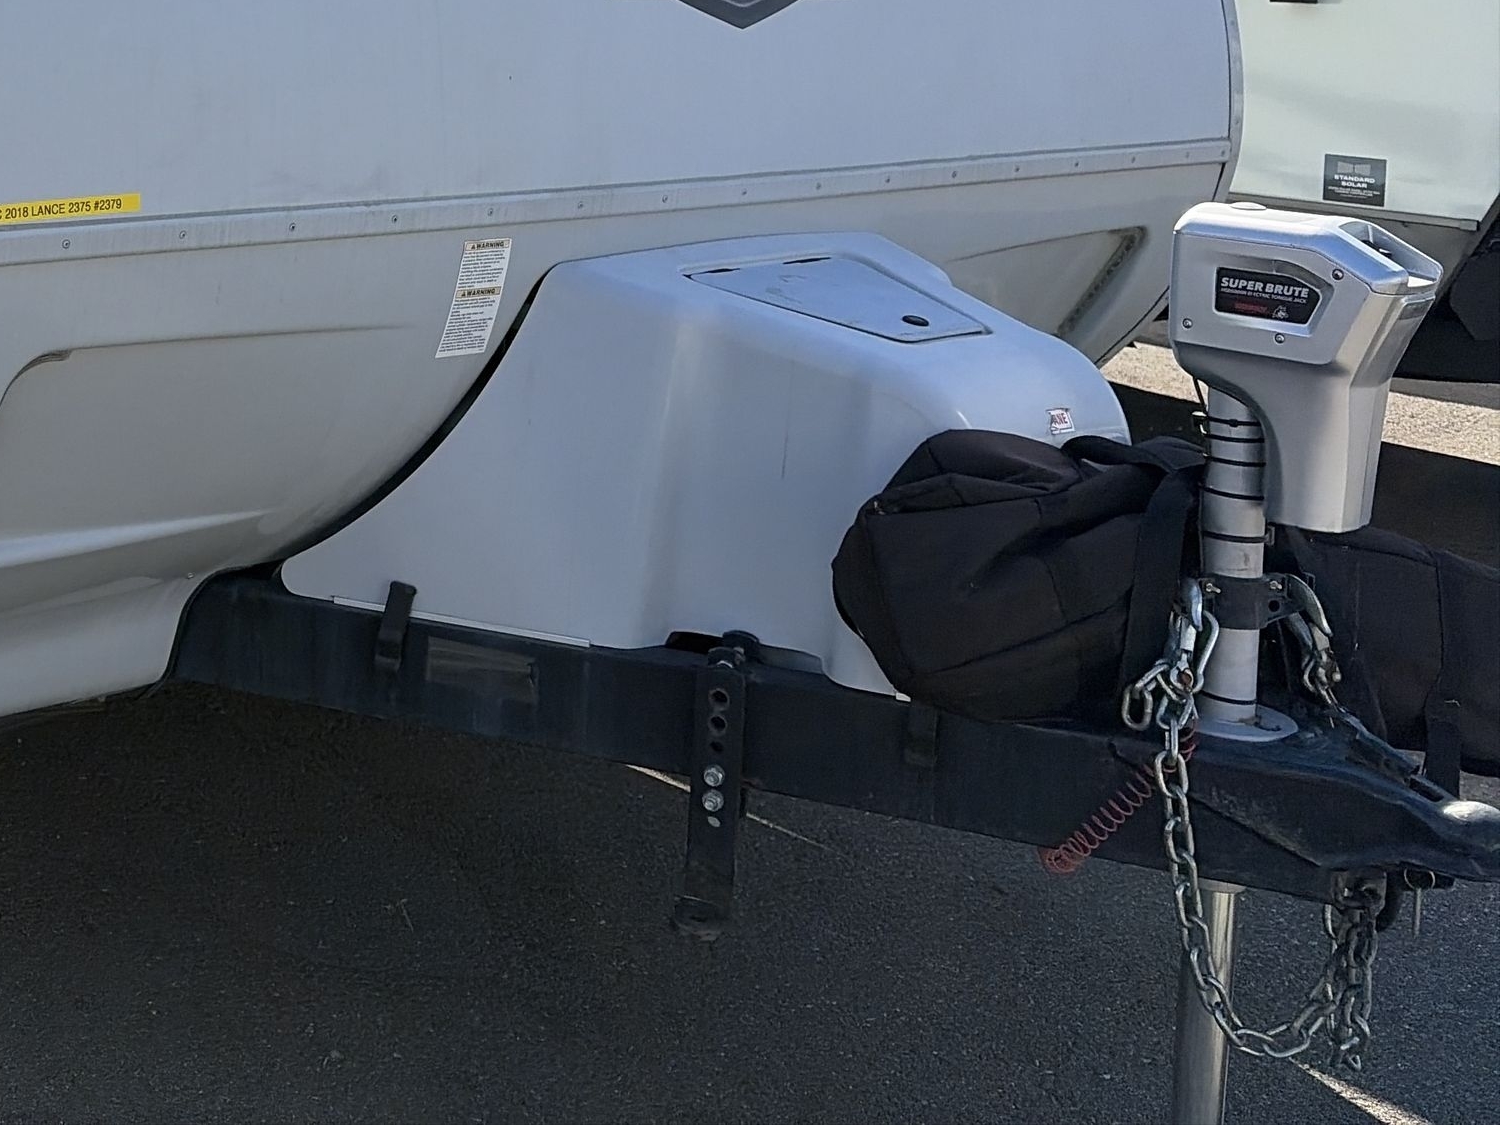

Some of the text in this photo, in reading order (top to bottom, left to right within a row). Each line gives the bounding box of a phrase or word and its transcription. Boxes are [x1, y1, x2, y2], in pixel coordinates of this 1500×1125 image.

[1334, 174, 1375, 183] STANDARD
[4, 206, 29, 219] 2018
[31, 203, 66, 217] LANCE
[68, 201, 92, 214] 2375
[93, 198, 122, 211] #2379
[476, 241, 504, 249] WARNING
[466, 288, 496, 296] WARNING
[1220, 277, 1263, 292] SUPER
[1265, 283, 1310, 298] BRUTE
